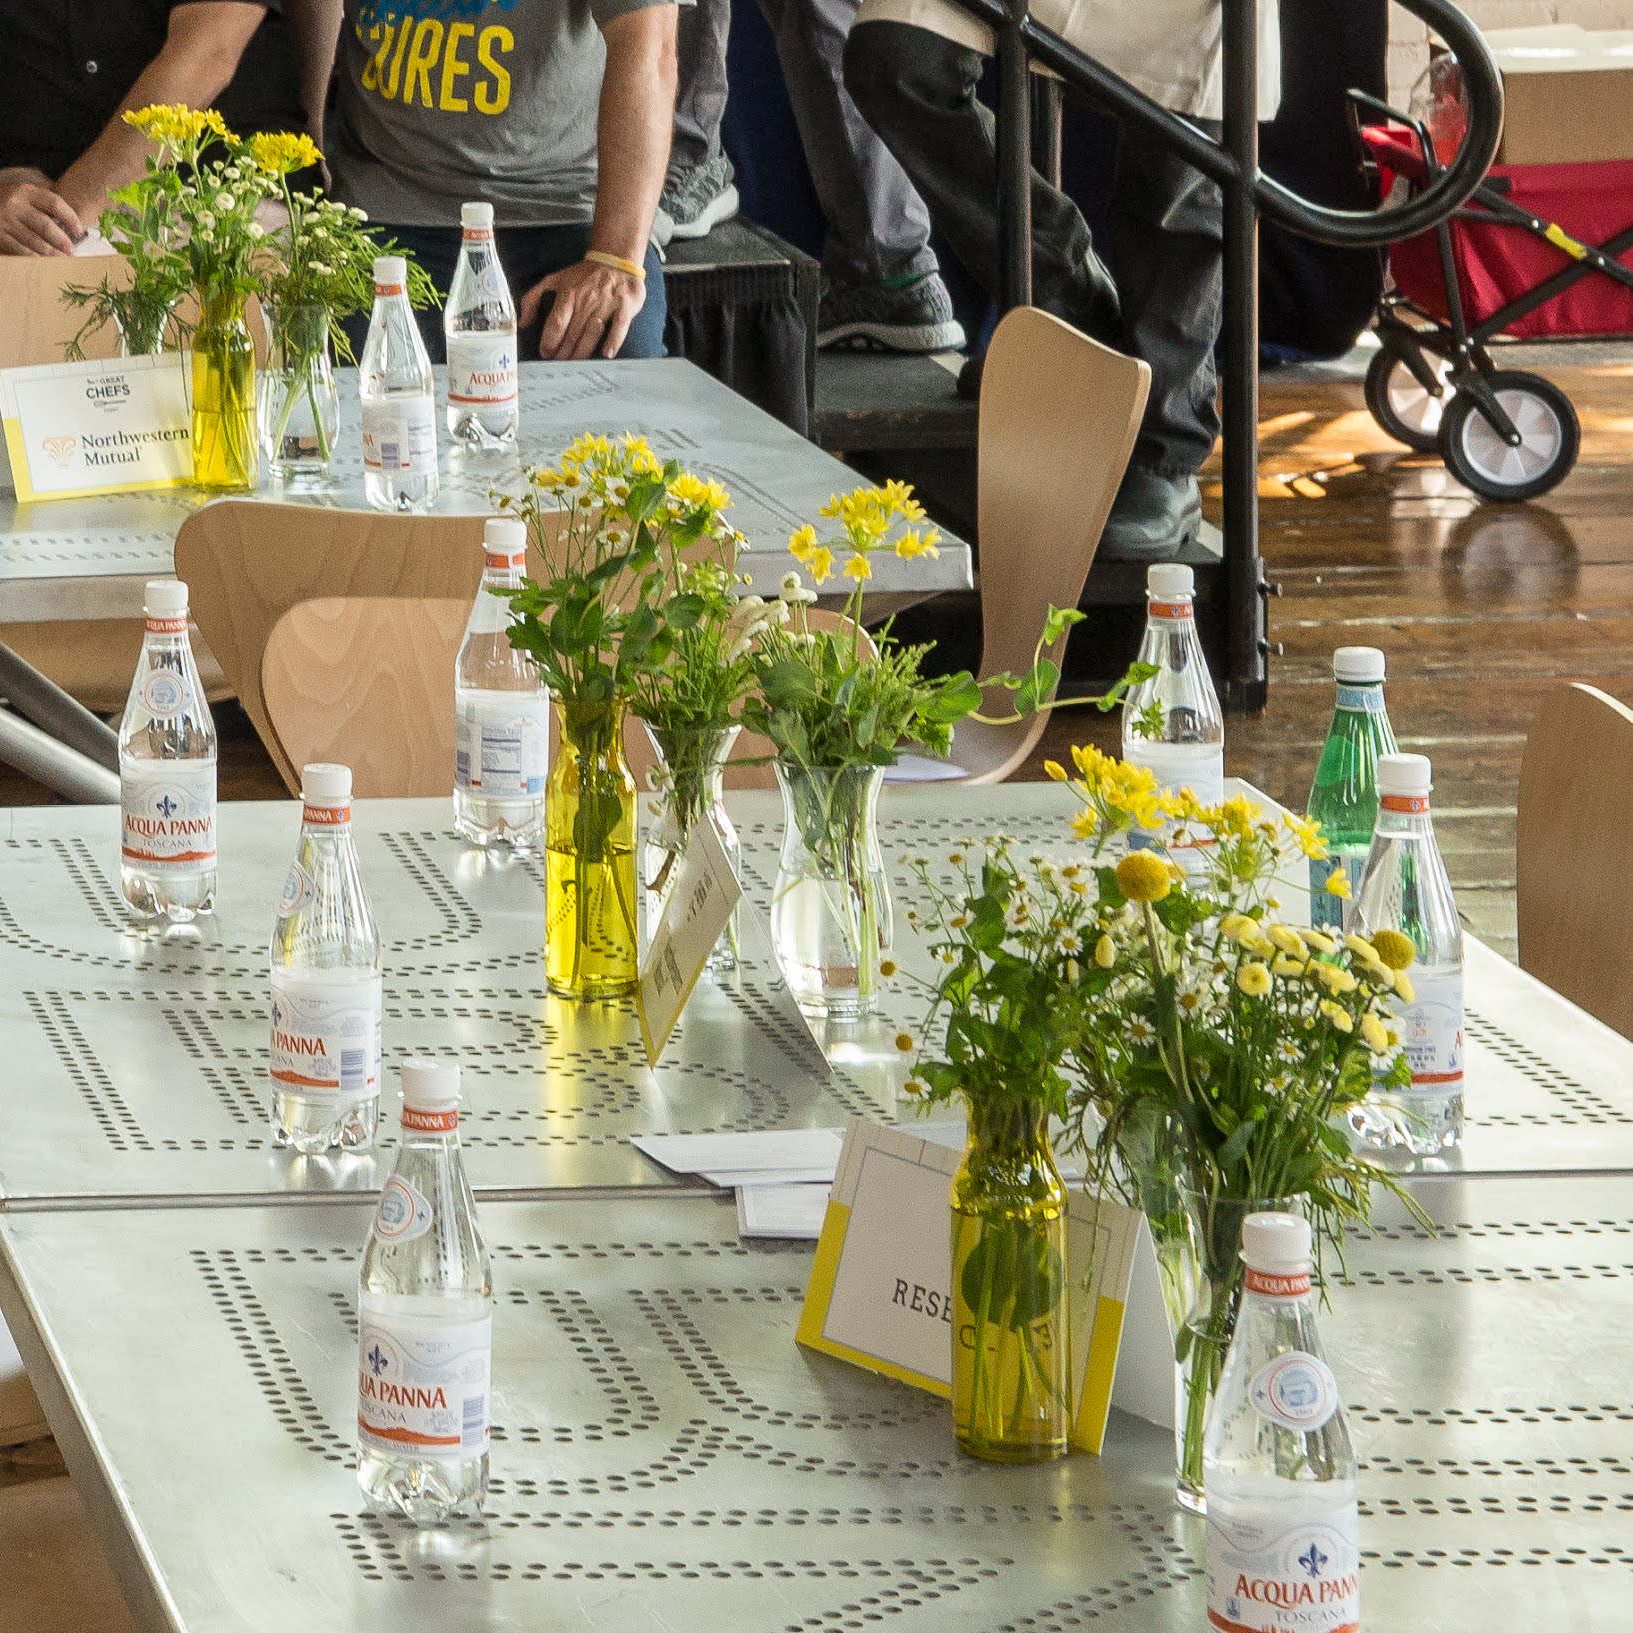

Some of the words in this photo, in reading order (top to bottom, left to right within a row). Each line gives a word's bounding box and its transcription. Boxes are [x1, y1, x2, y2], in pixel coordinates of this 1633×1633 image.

[86, 384, 131, 399] CHEFS
[81, 428, 190, 450] Northwestern
[125, 814, 167, 838] ACQUA
[170, 815, 213, 836] PANNA
[142, 837, 194, 849] TOSCANA
[276, 1030, 327, 1056] PANNA
[1254, 1273, 1288, 1294] ACQUA
[379, 1385, 448, 1411] PANNA
[1235, 1573, 1314, 1610] ACQUA
